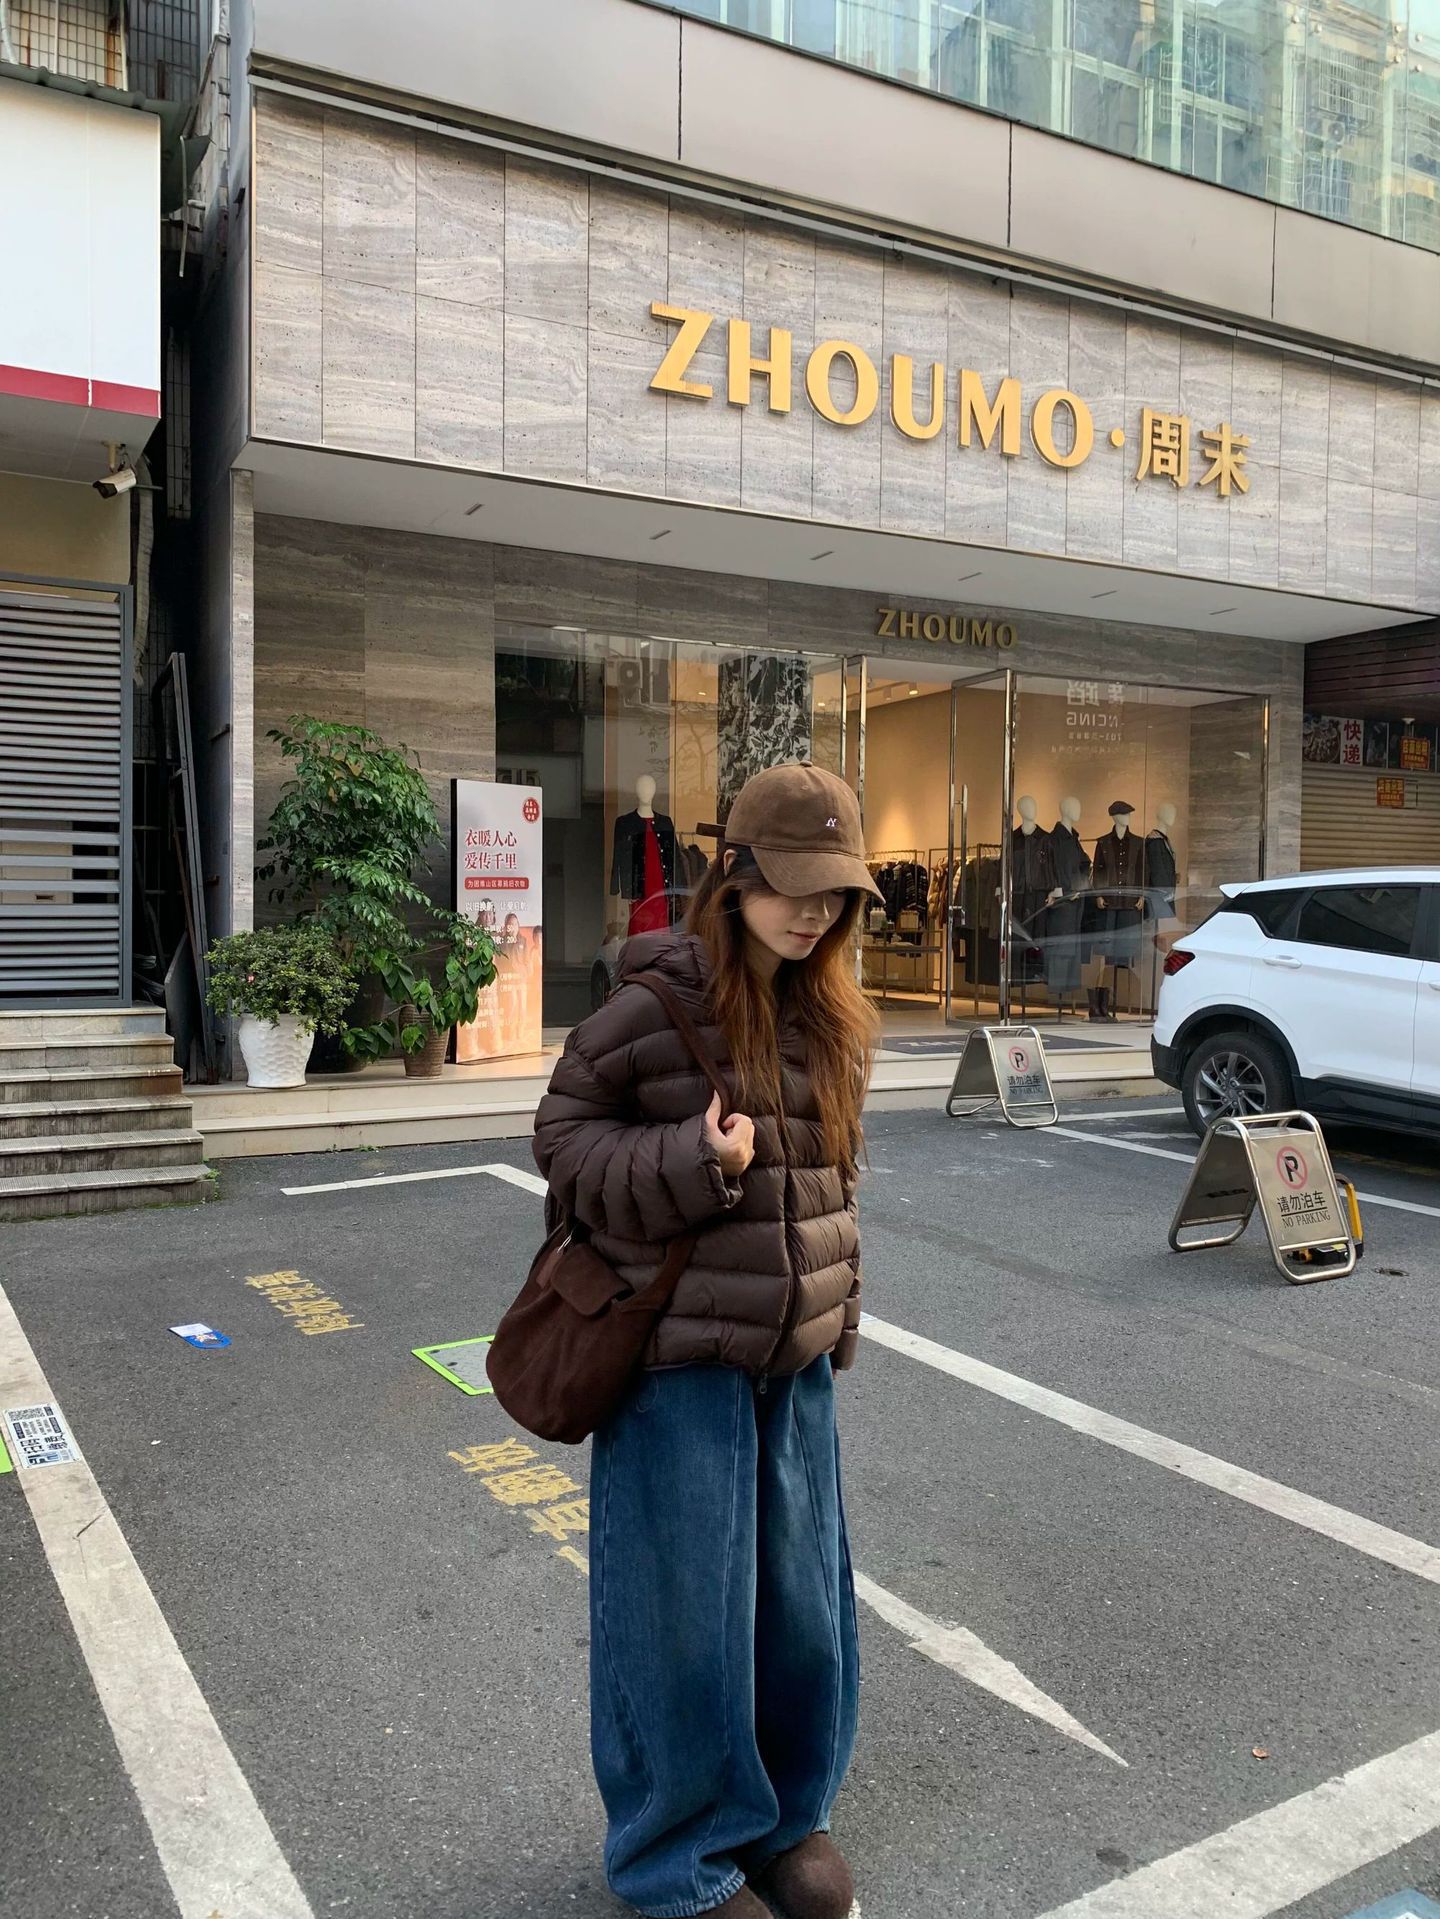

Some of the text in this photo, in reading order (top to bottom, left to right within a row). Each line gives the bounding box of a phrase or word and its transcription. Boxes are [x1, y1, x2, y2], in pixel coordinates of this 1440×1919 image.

[877, 607, 1019, 650] ZHOUMO
[1343, 720, 1362, 765] 快递
[465, 829, 517, 847] 衣暖人心
[464, 852, 517, 870] 爱传千里
[1007, 1075, 1040, 1085] 请勿泊车
[1277, 1191, 1325, 1212] 请勿泊车
[1282, 1210, 1331, 1228] NO PARKING
[449, 1437, 590, 1575] 有翻板
